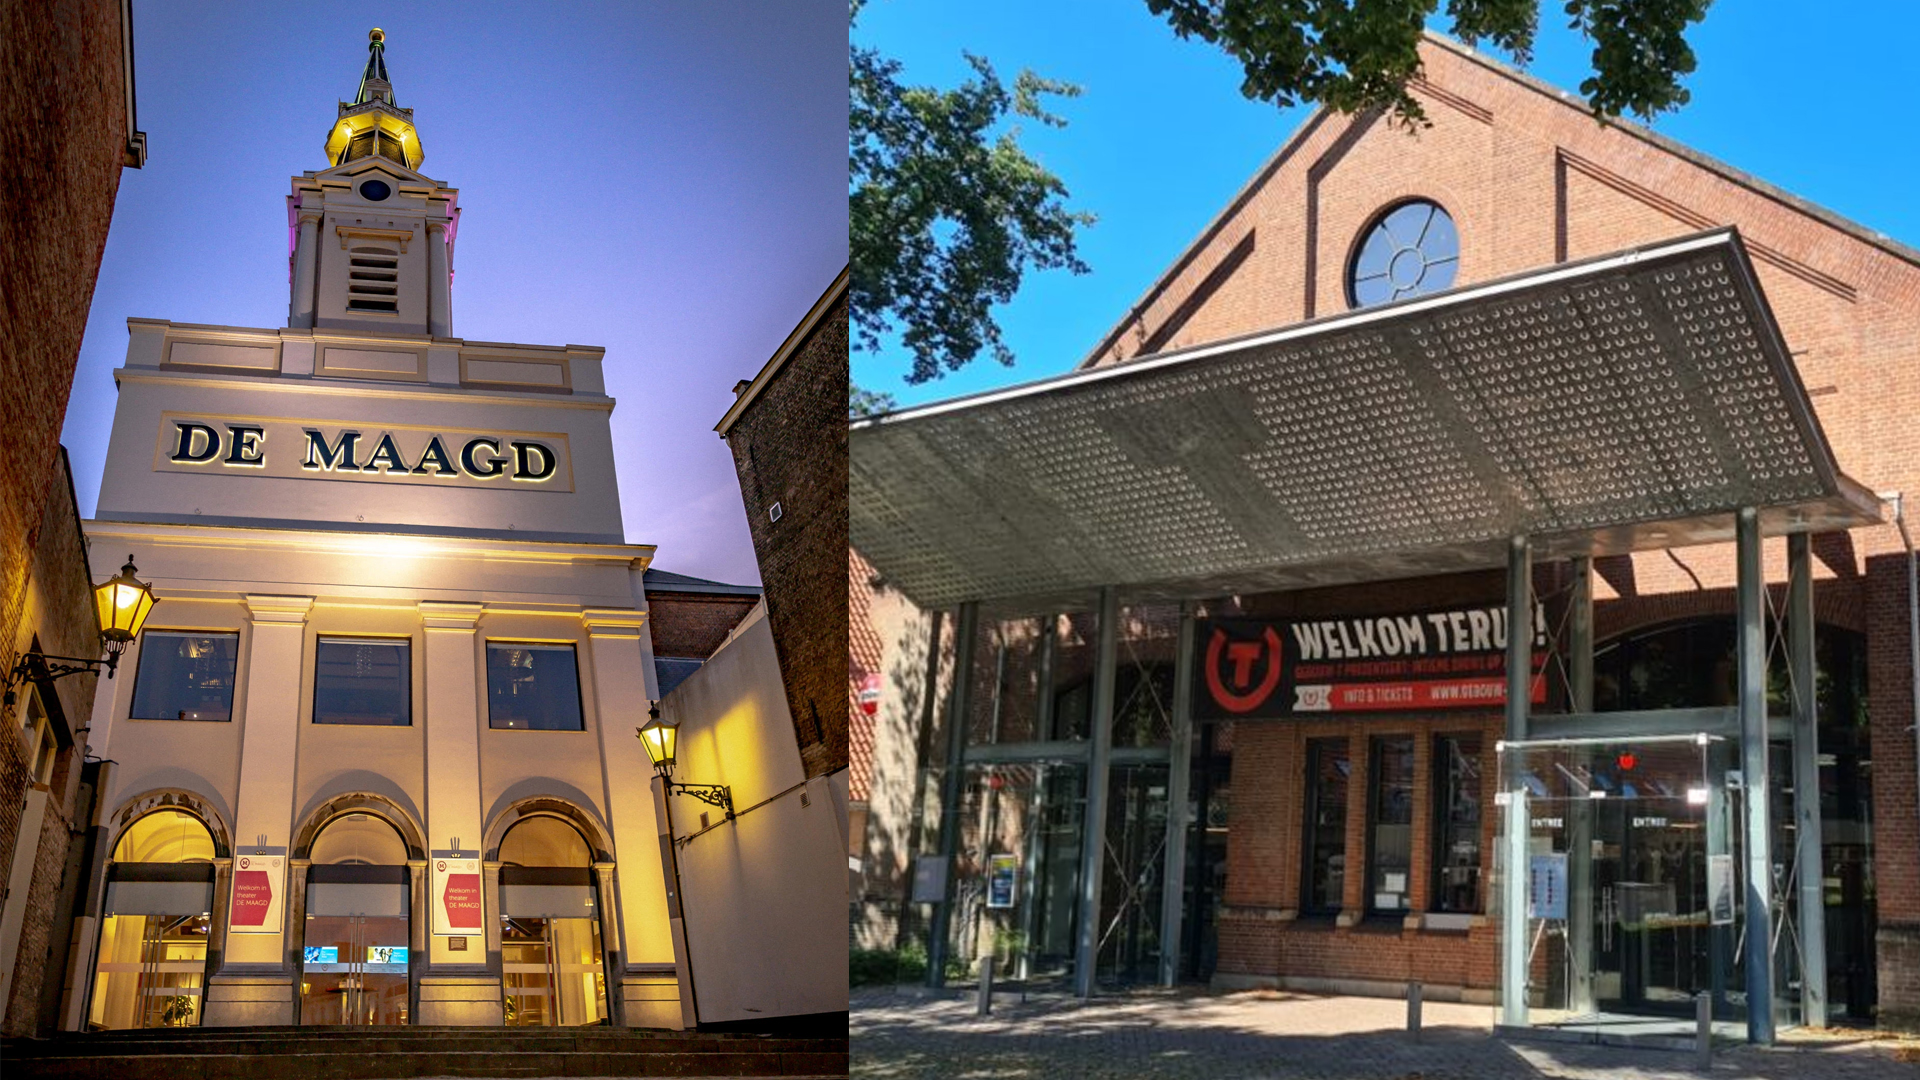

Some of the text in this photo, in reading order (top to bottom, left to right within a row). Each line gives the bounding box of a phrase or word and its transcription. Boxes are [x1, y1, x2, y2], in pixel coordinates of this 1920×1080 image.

[171, 423, 558, 482] DE MAAGD
[1291, 603, 1546, 660] WELKOM TERU!
[1344, 689, 1366, 703] INFO
[1376, 686, 1413, 702] TICKETS
[1531, 817, 1563, 828] ENTREE
[1631, 816, 1667, 828] ENTREE
